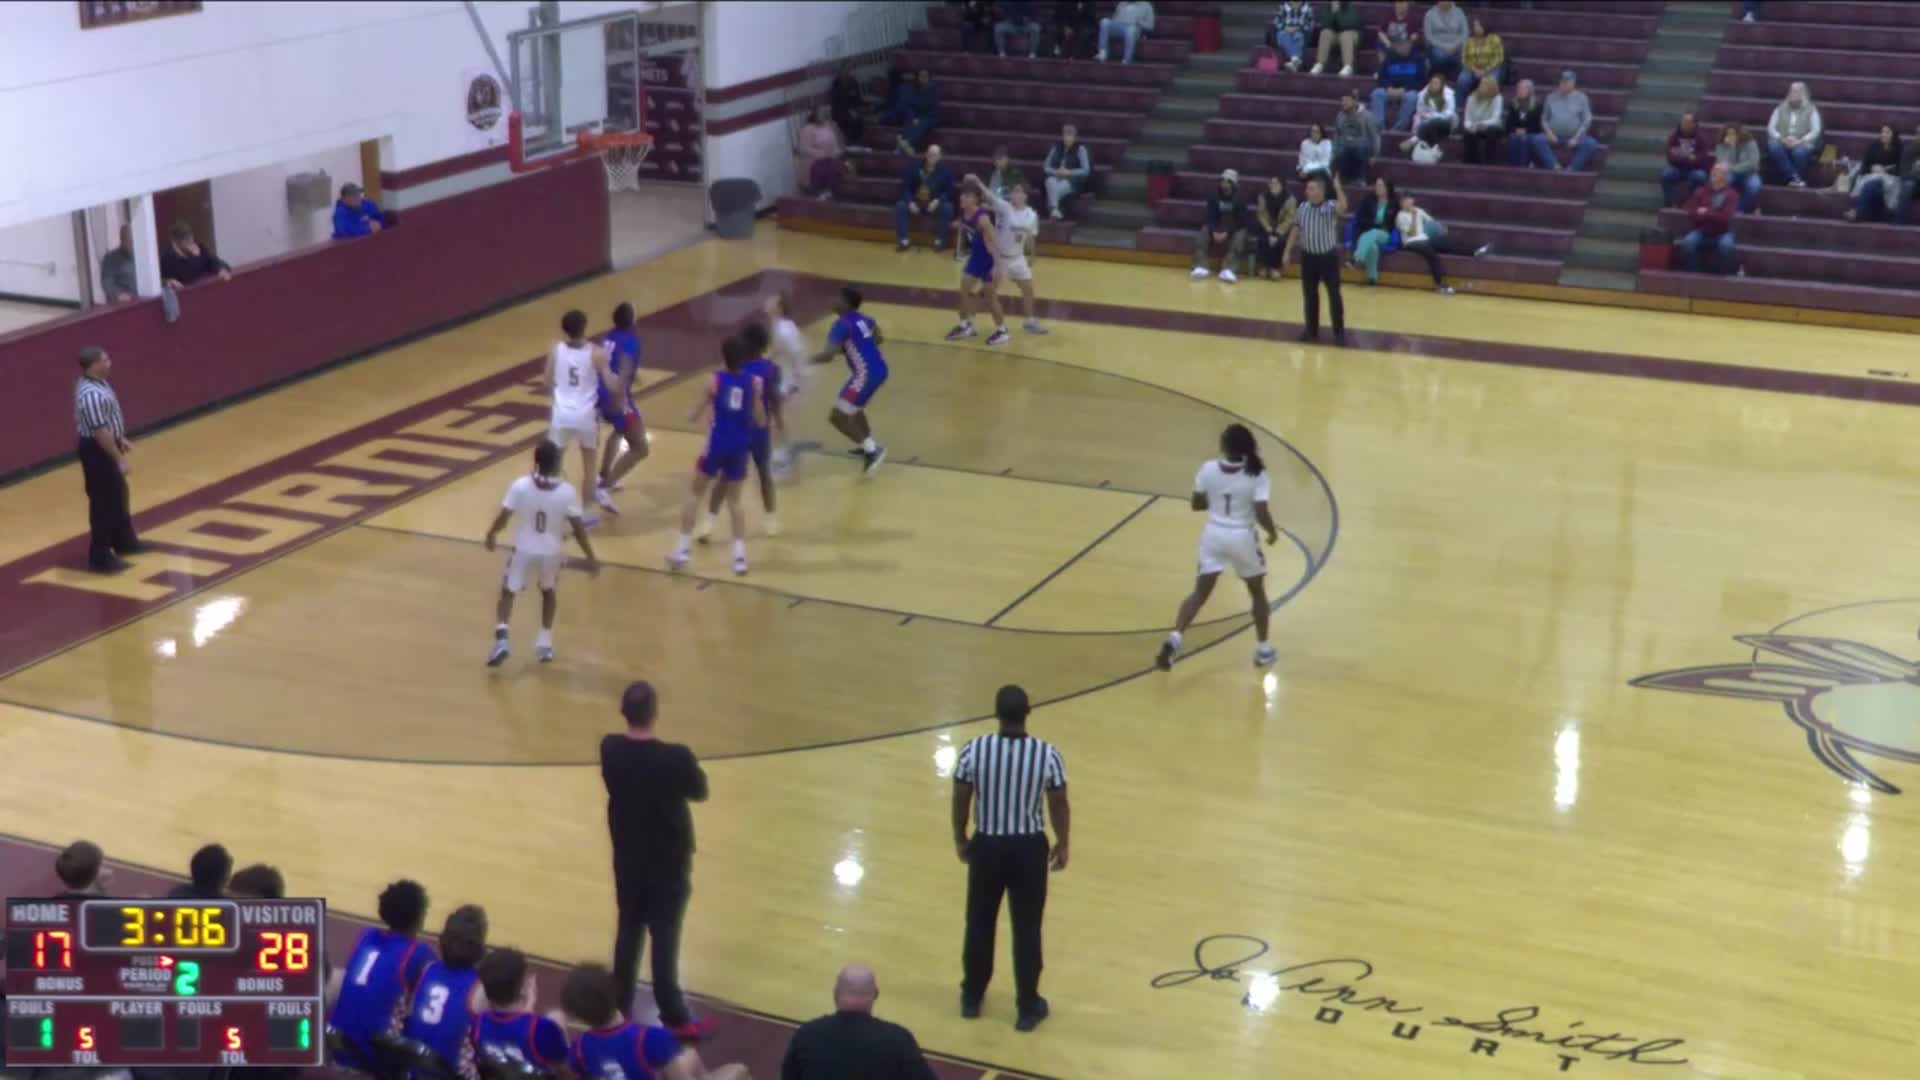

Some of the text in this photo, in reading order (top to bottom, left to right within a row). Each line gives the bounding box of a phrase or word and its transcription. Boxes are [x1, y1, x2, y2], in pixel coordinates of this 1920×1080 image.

[568, 367, 579, 386] 5
[1222, 493, 1233, 516] 1
[535, 509, 547, 534] 0
[354, 949, 380, 986] 1
[421, 984, 449, 1025] 3
[1430, 1005, 1689, 1065] Smith
